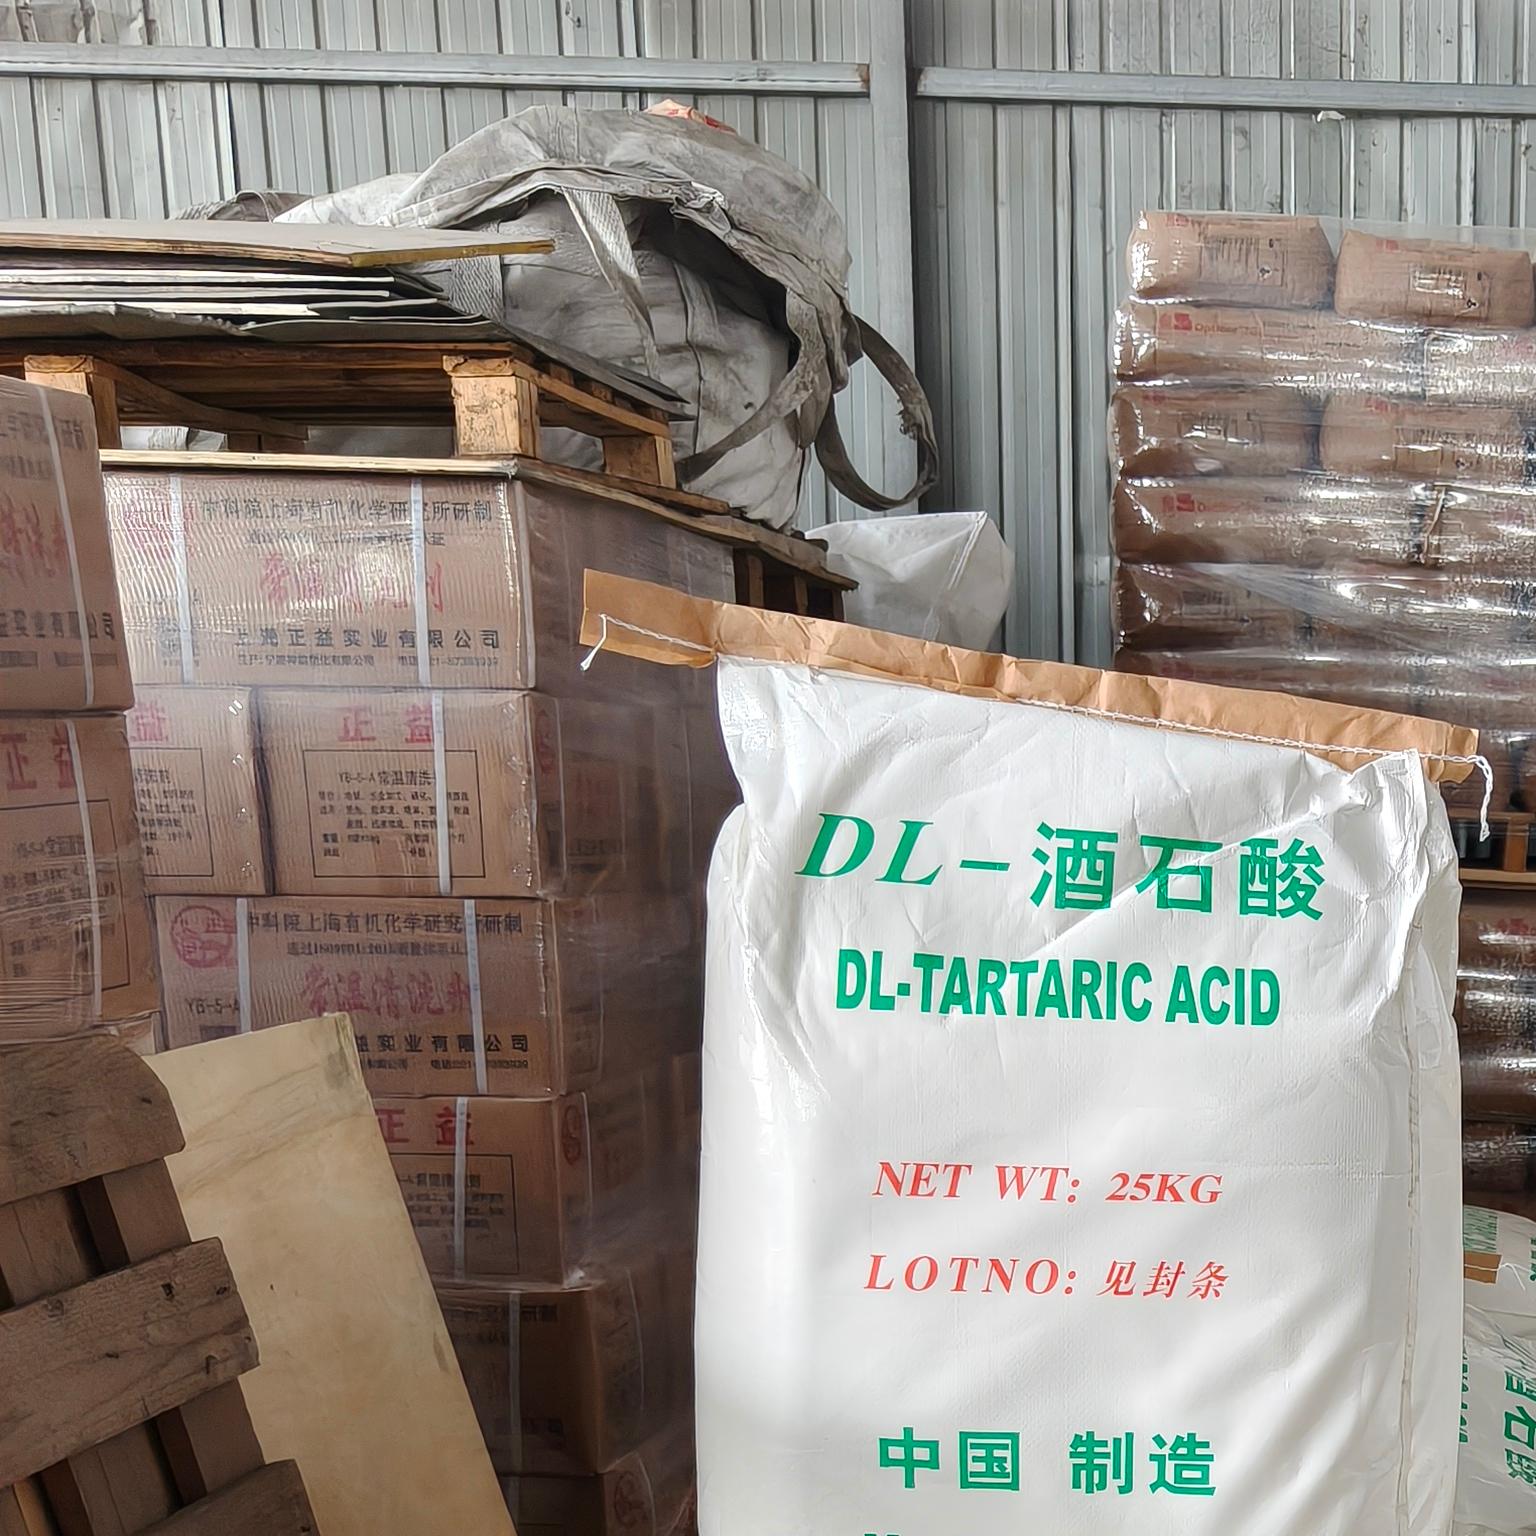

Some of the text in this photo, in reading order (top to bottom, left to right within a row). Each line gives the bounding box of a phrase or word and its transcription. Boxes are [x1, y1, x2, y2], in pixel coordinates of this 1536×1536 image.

[834, 947, 1282, 1027] DL-TARTARIC ACID
[871, 1160, 1224, 1205] NET WT: 25KG
[863, 1253, 1230, 1300] LOTNO: 见封条
[876, 1425, 1218, 1498] 中国 制造
